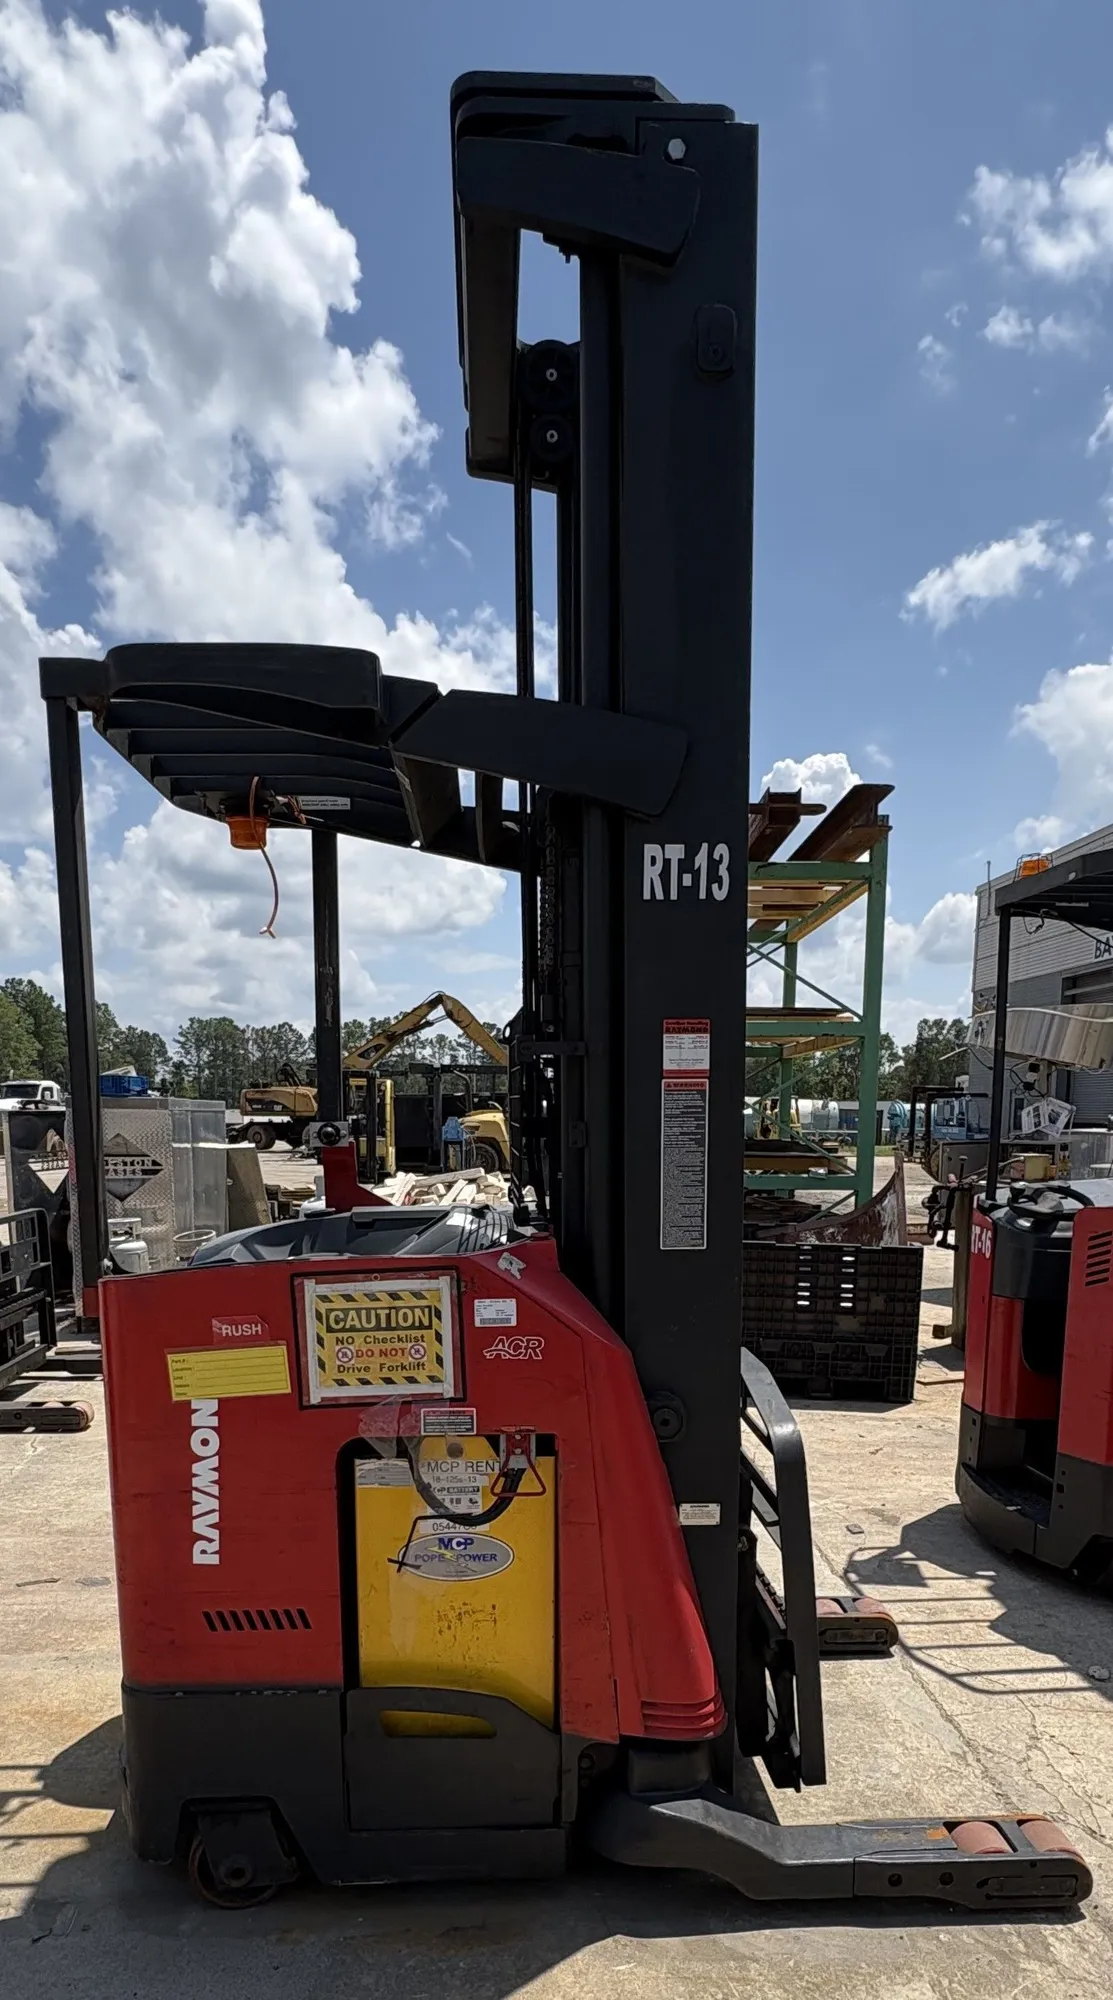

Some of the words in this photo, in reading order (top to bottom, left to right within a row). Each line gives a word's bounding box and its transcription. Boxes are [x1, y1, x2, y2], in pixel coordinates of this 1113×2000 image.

[643, 842, 730, 901] RT-13
[1094, 936, 1113, 960] BA
[105, 1159, 152, 1167] ESTON
[105, 1168, 142, 1177] ASES
[329, 1307, 430, 1330] CAUTION
[221, 1323, 262, 1337] RUSH
[335, 1335, 355, 1346] NO
[363, 1334, 426, 1345] Checklist
[355, 1348, 375, 1359] DO
[379, 1347, 408, 1358] NOT
[483, 1336, 545, 1360] ACR
[337, 1363, 371, 1374] Drive
[379, 1361, 426, 1373] Forklift
[427, 1461, 459, 1473] MCP
[190, 1398, 220, 1565] RAYMON
[438, 1537, 475, 1551] MCP
[456, 1553, 498, 1562] POWER
